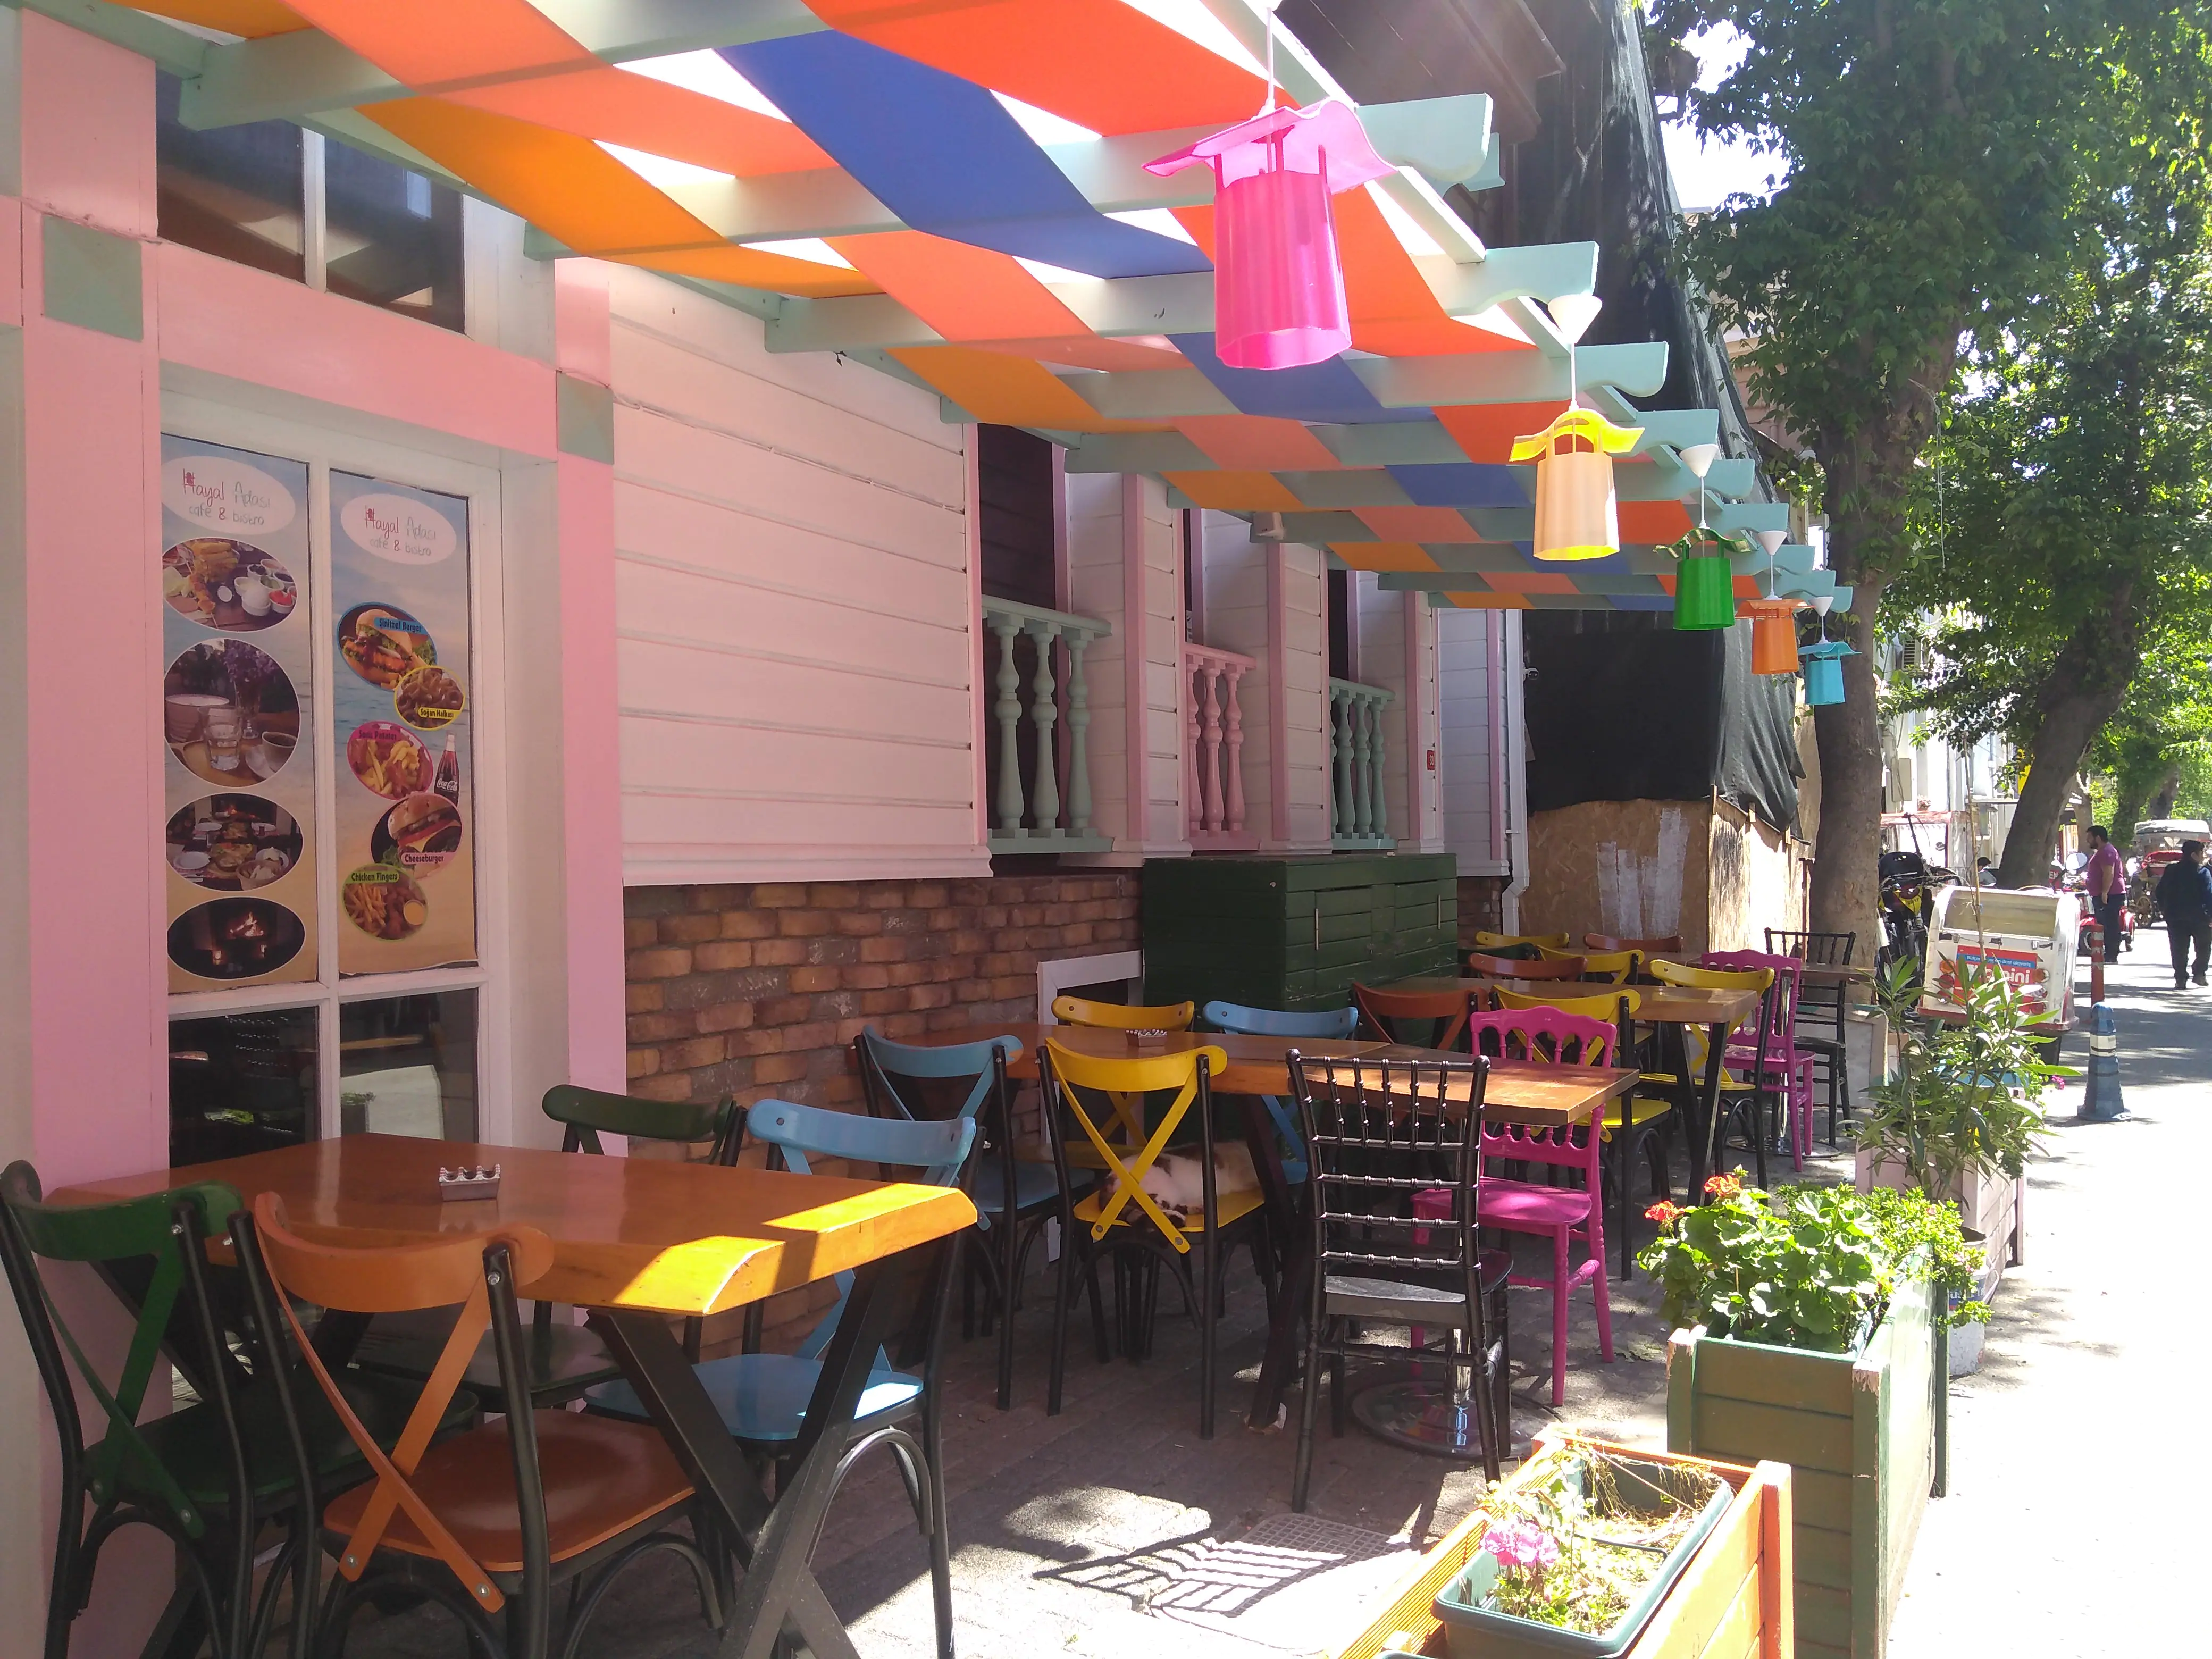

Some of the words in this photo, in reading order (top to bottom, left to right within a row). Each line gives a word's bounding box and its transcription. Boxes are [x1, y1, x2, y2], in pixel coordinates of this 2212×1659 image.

[182, 468, 224, 507] Hayal
[219, 507, 227, 520] &
[233, 510, 265, 525] bistro
[364, 505, 399, 539] Hayal
[394, 540, 401, 551] &
[405, 542, 431, 556] bistro
[403, 622, 422, 633] Burger
[405, 854, 444, 863] Cheeseburger
[351, 873, 375, 881] Chicken
[377, 872, 398, 882] Fingers
